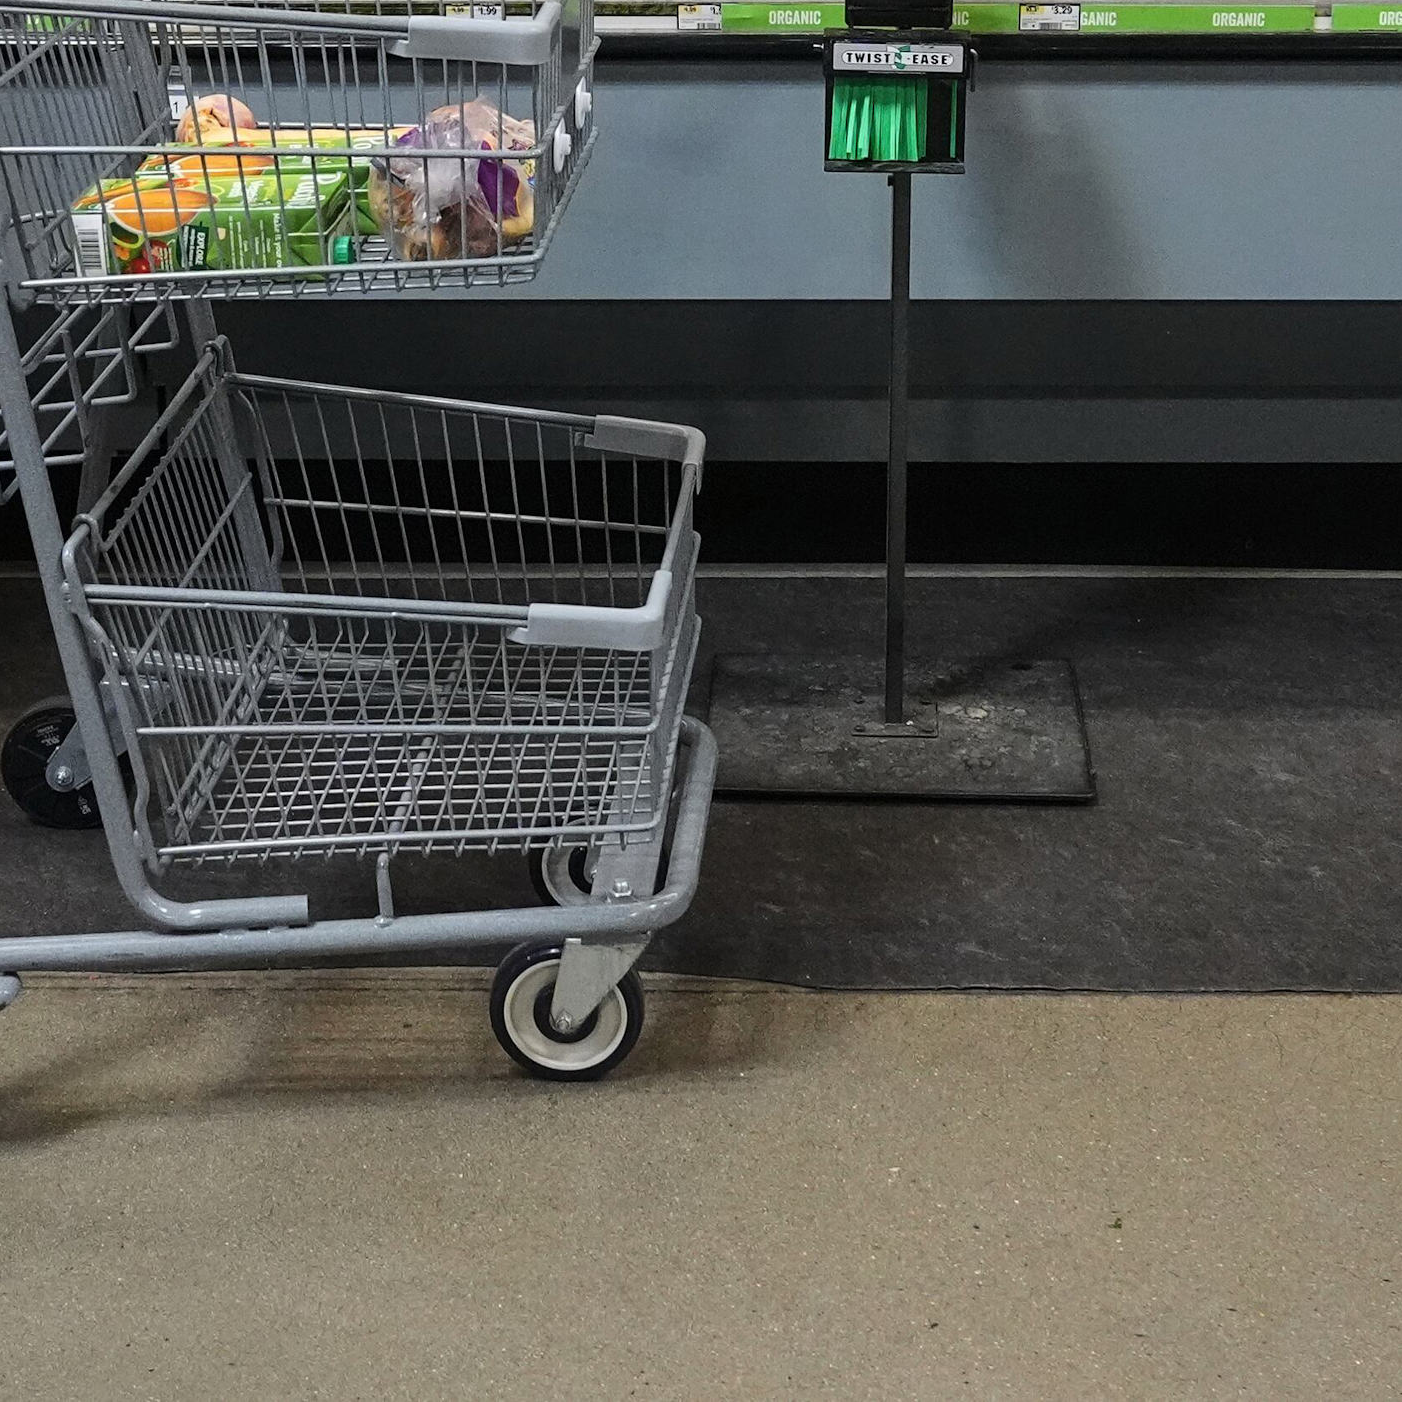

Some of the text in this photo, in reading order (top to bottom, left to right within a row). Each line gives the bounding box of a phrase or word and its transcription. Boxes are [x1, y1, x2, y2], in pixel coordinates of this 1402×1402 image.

[769, 10, 821, 25] ORGANIC
[1081, 11, 1117, 26] GANIC
[1212, 13, 1265, 27] ORGANIC
[846, 52, 891, 63] TWIST
[195, 232, 206, 265] EXPLORE
